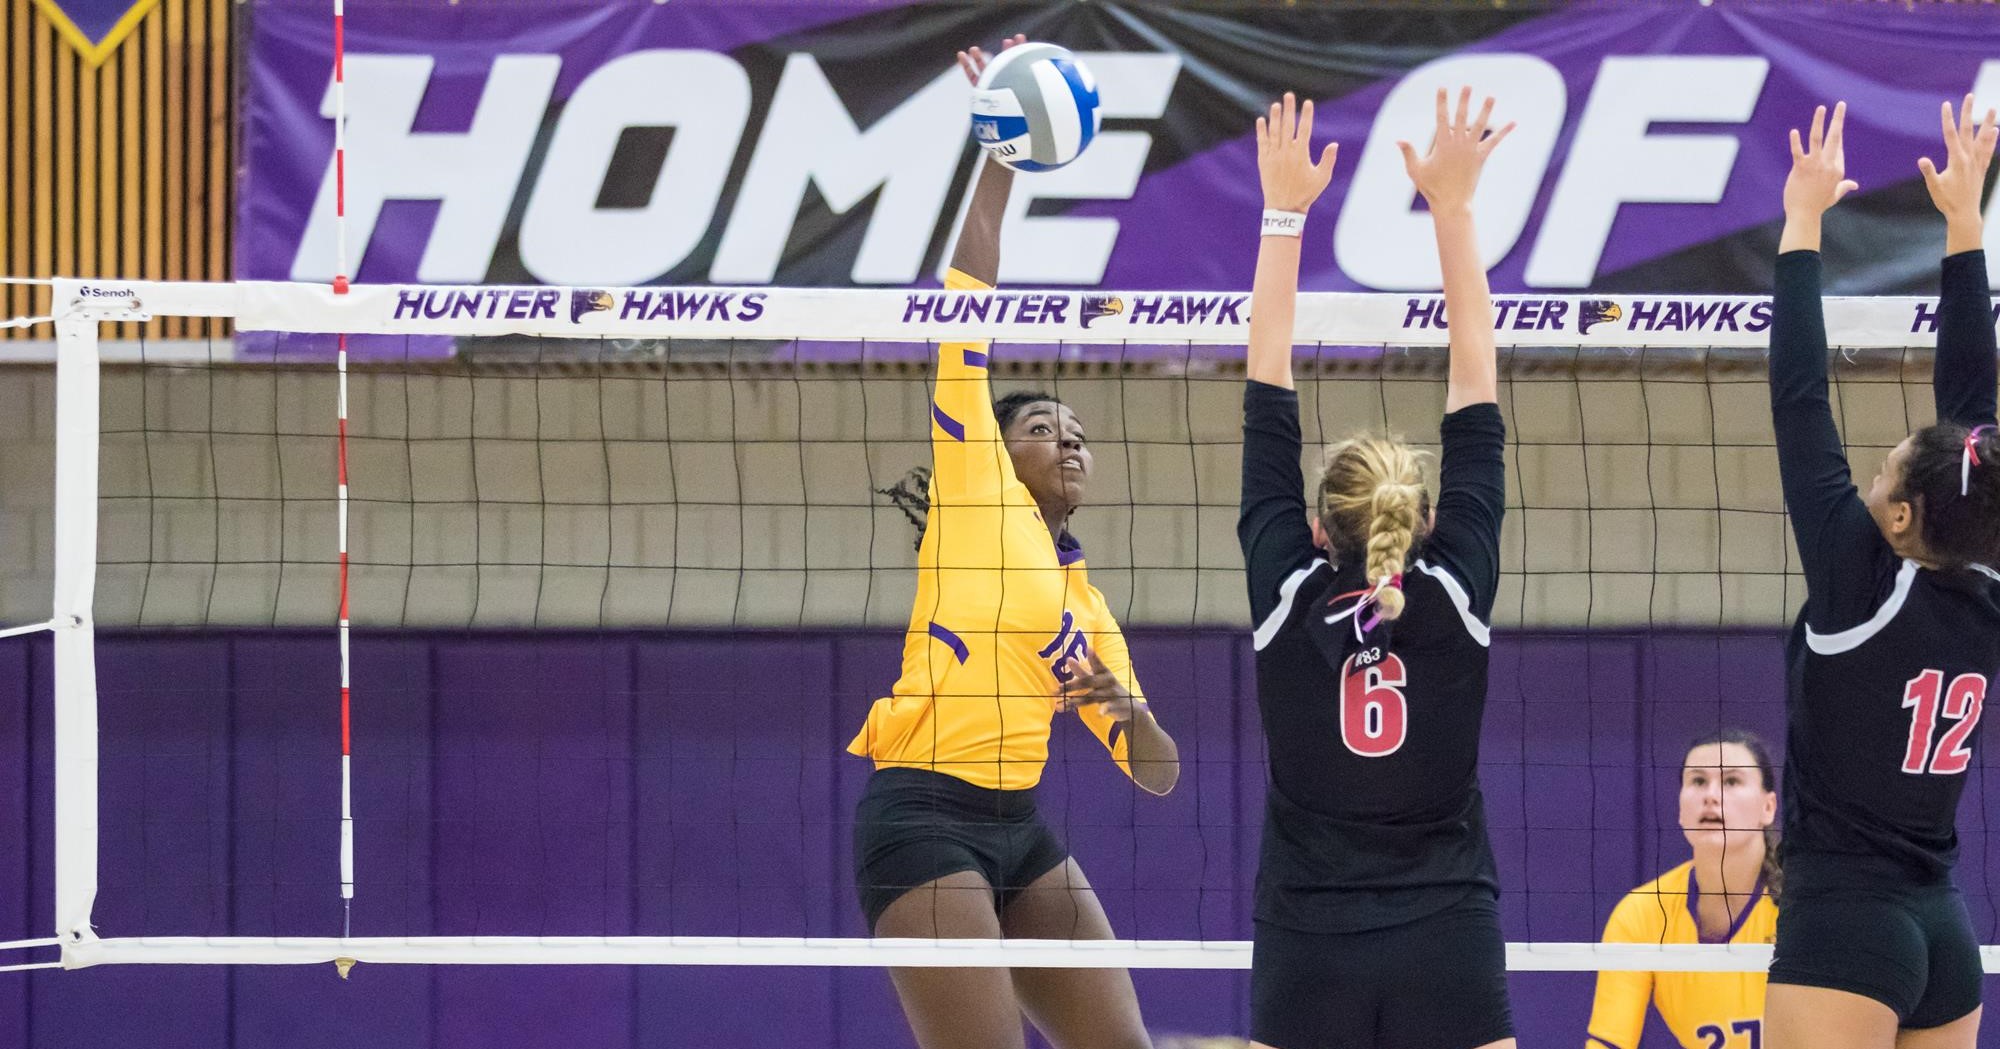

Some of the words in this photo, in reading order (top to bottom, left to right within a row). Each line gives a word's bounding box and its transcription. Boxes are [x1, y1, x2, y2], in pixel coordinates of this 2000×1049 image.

[290, 49, 1182, 286] HOME
[1334, 52, 1770, 291] OF
[92, 287, 135, 298] Senoh
[393, 289, 561, 320] HUNTER
[619, 290, 769, 322] HAWKS
[902, 294, 1071, 325] HUNTER
[1128, 295, 1252, 326] HAWK
[1626, 301, 1773, 333] HAWKS
[1340, 651, 1407, 757] 6
[1901, 668, 1987, 775] 12
